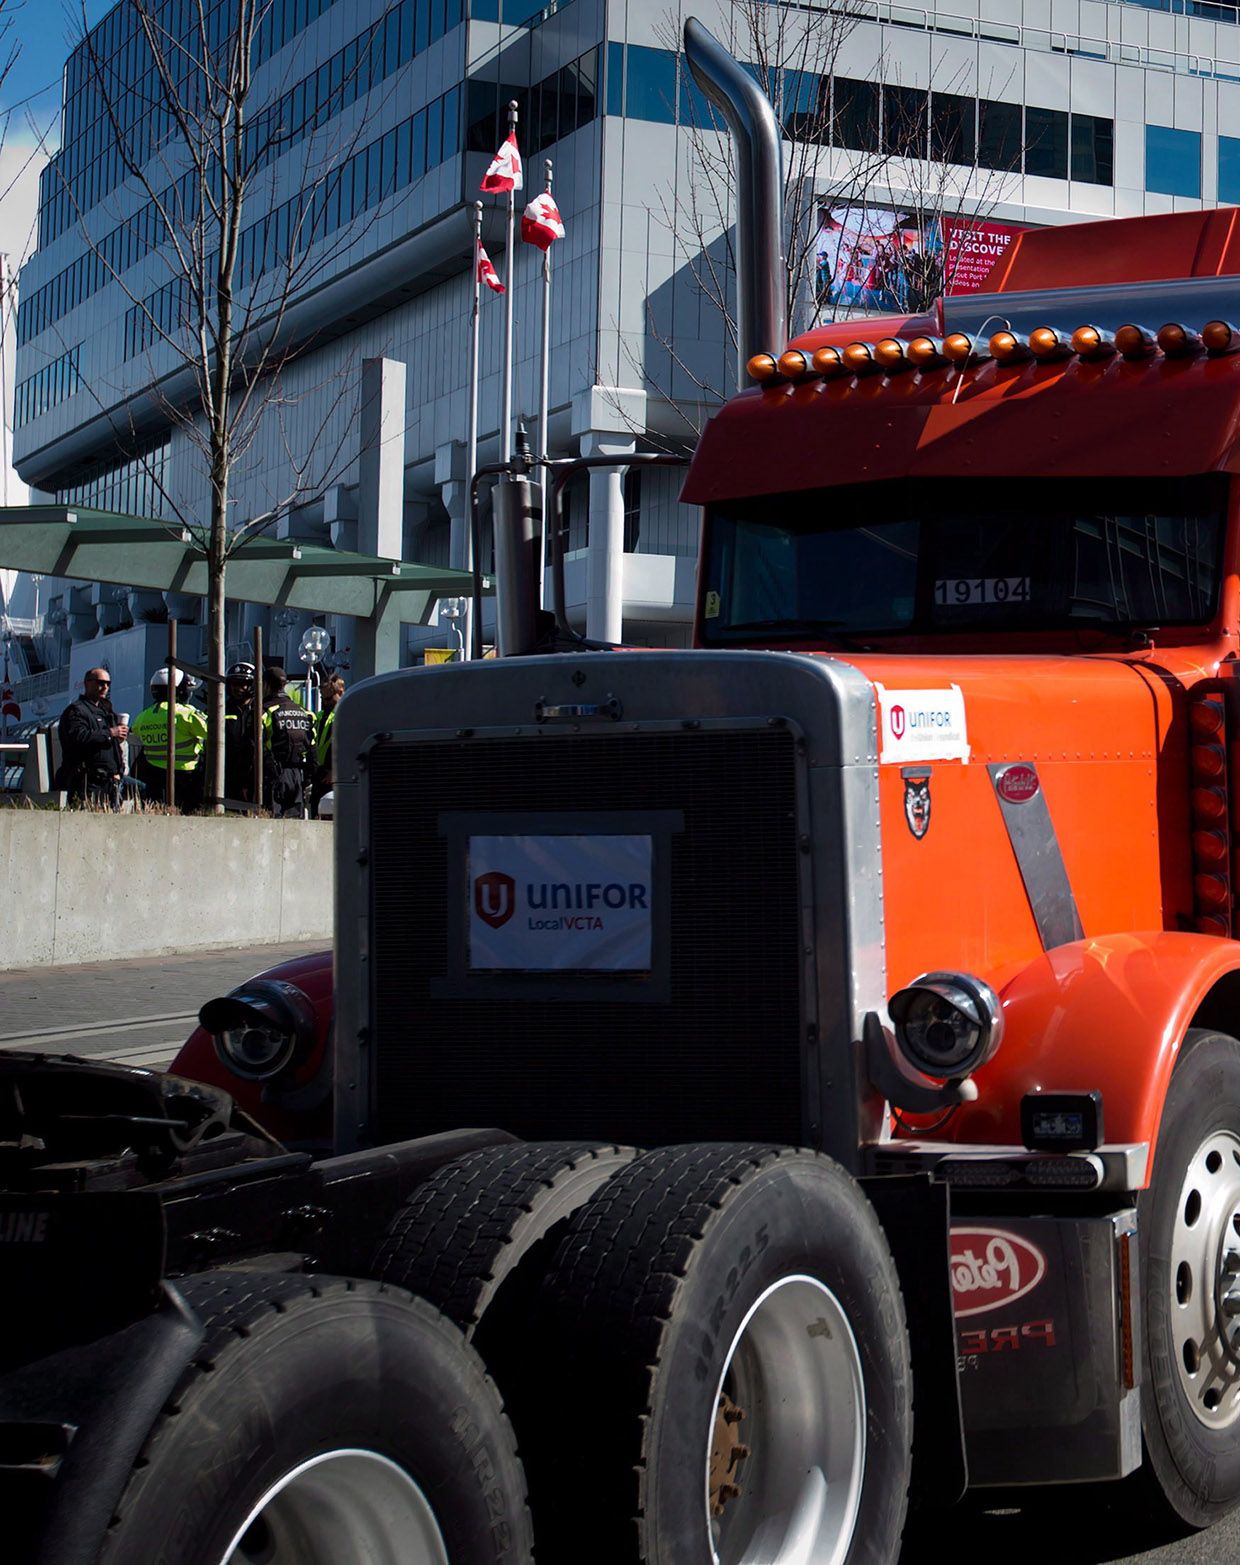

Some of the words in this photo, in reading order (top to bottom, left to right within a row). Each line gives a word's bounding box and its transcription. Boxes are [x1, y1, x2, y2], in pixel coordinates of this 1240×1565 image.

[949, 228, 984, 241] VISIT
[987, 233, 1011, 245] THE
[949, 240, 1004, 256] DSCOVE
[949, 255, 974, 263] Loated
[935, 579, 1029, 603] 19104
[908, 711, 952, 728] UNIFOR
[142, 733, 168, 744] POLIC
[526, 882, 649, 910] UNIFOR
